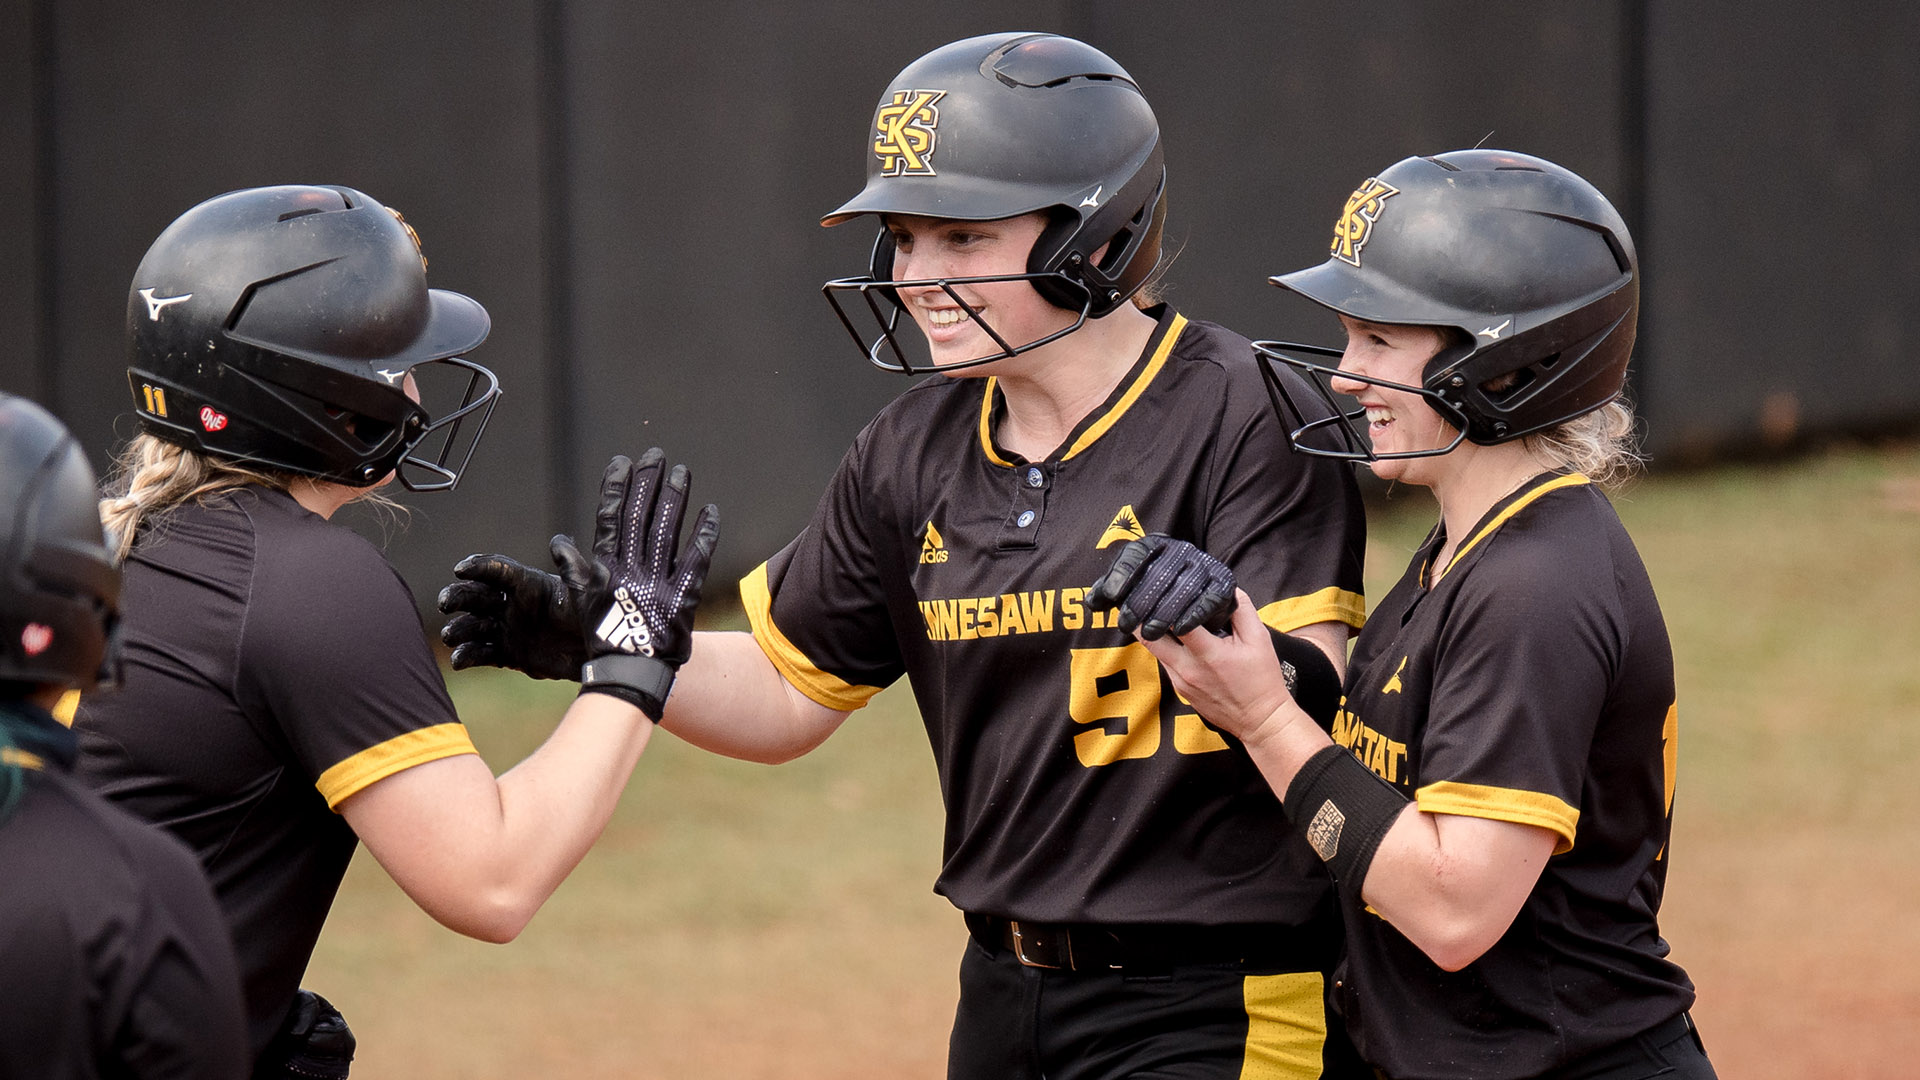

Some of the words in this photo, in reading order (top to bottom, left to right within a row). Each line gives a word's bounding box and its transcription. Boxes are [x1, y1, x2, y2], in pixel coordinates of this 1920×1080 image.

[142, 383, 168, 418] 11
[200, 408, 226, 429] ONE
[614, 587, 655, 658] adidas
[918, 589, 1056, 641] NNESAW
